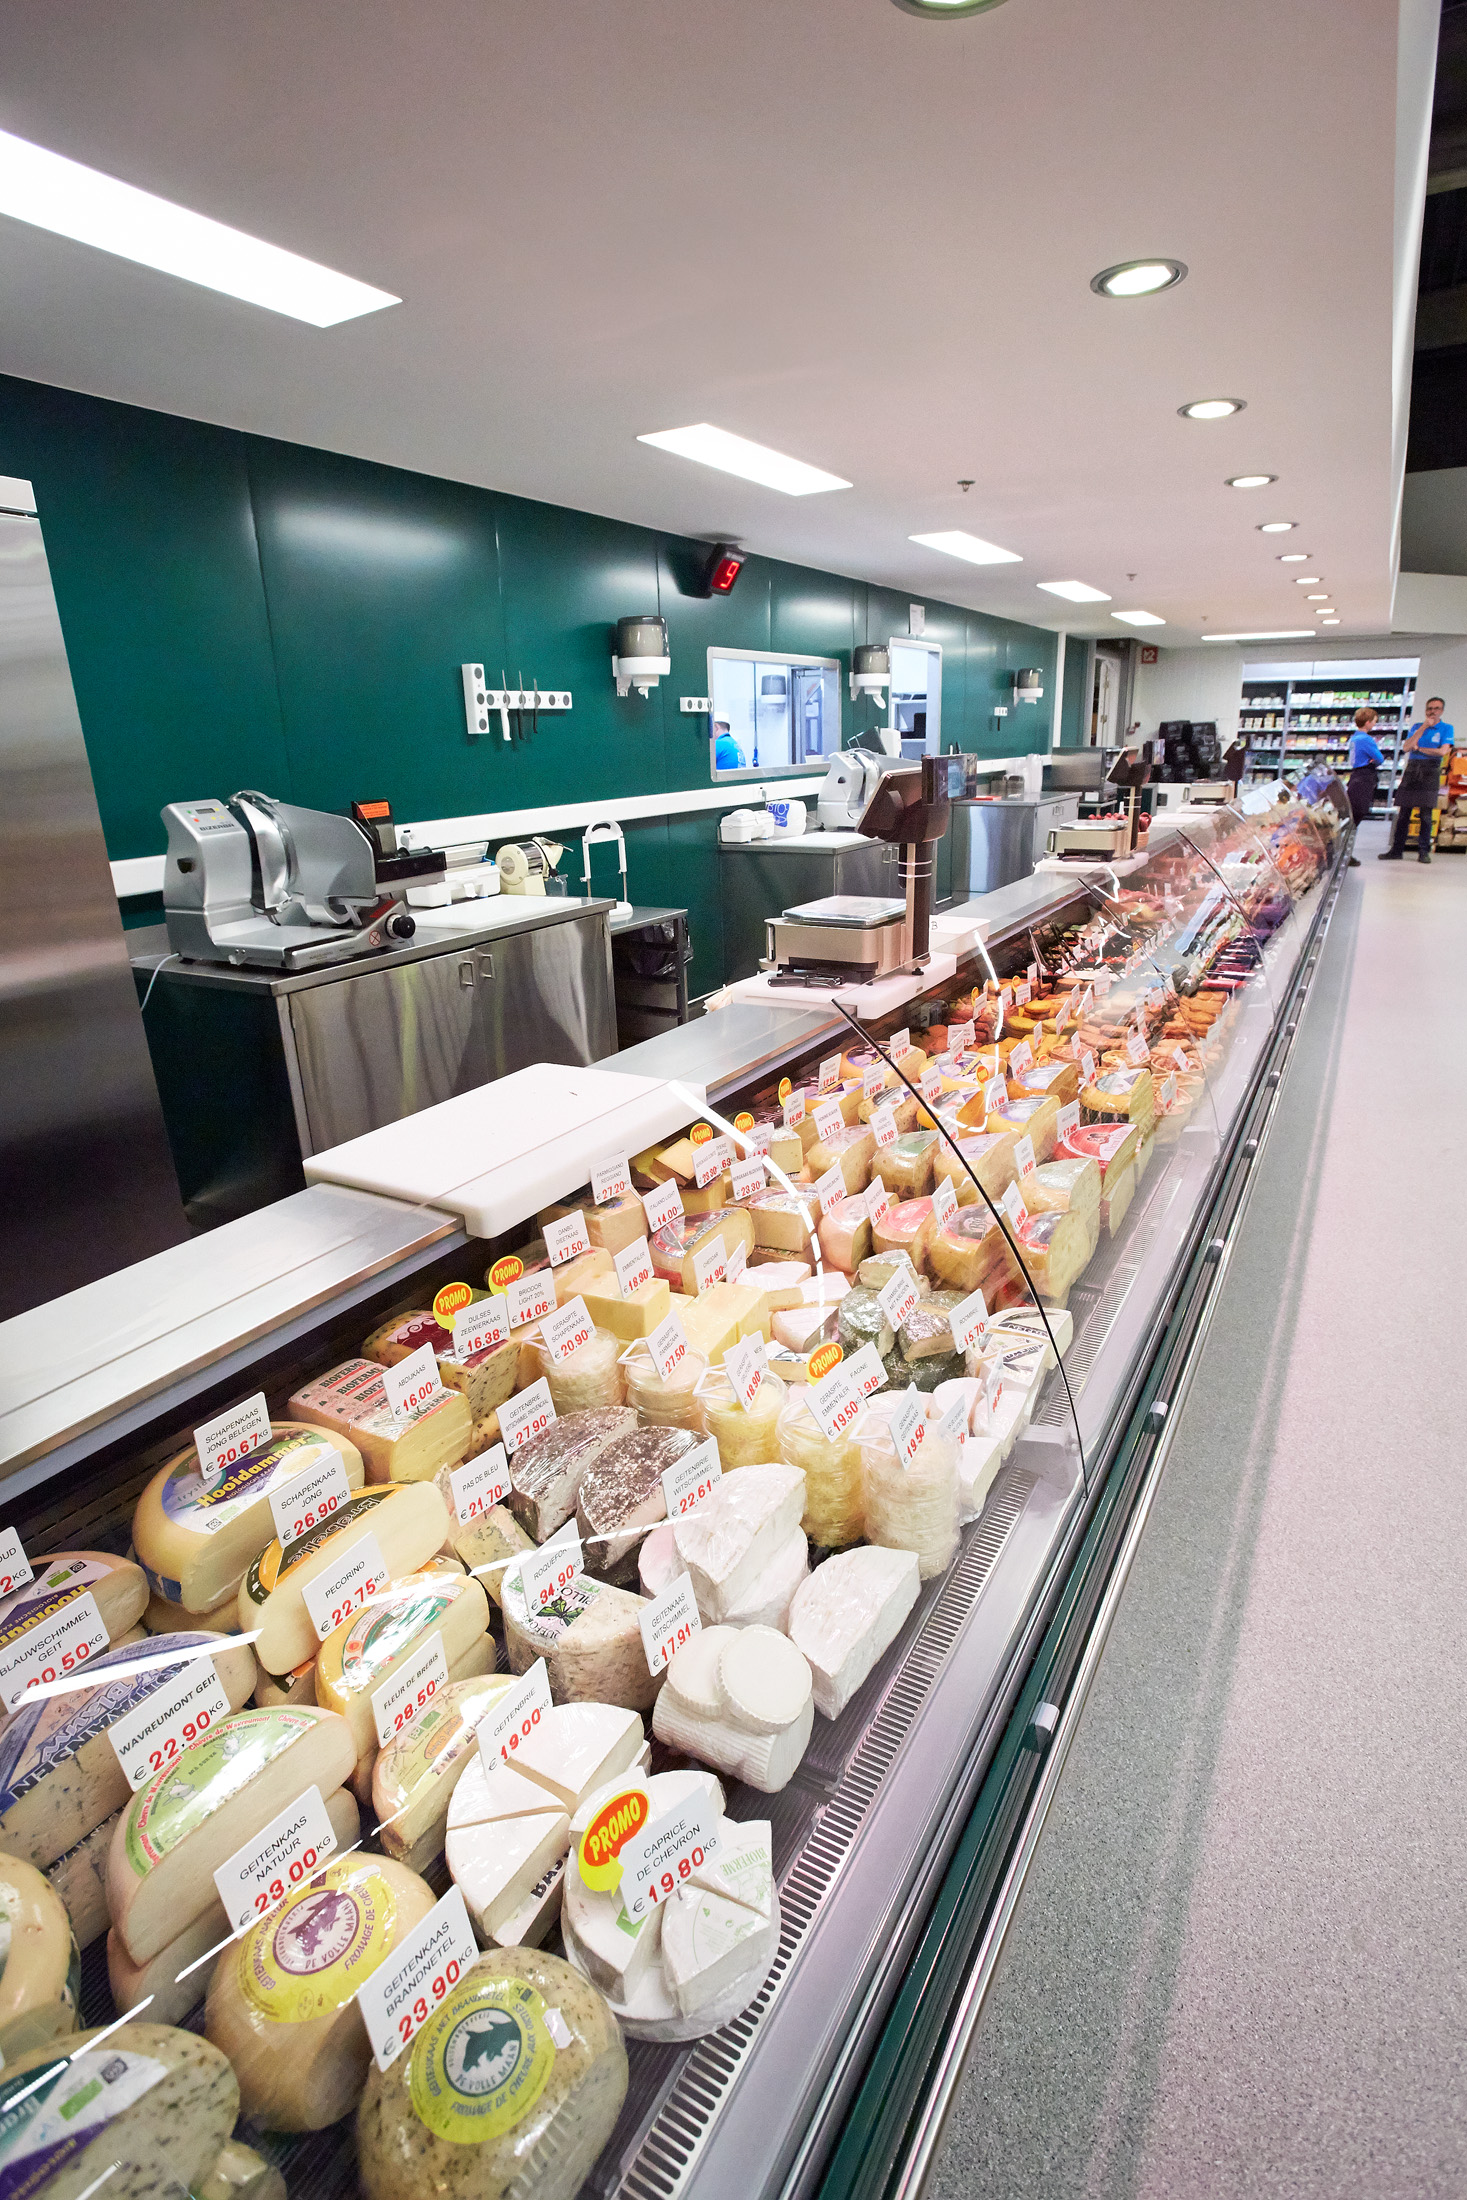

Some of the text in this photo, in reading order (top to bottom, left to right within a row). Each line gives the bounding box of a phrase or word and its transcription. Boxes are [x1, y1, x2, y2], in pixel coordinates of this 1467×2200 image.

[720, 561, 740, 589] 9
[694, 1128, 710, 1141] PROMO
[495, 1263, 519, 1282] PROMO
[439, 1288, 467, 1312] PROMO
[518, 1282, 542, 1297] BRIODOR
[518, 1291, 545, 1306] LIGHT 20%
[460, 1315, 500, 1336] ZEEWIERKAAS
[551, 1316, 585, 1342] SCHAPENKAAS
[552, 1311, 578, 1331] GERASPTE
[319, 1360, 367, 1388] BIOFERME
[398, 1365, 426, 1388] ABDIJKAAS
[811, 1347, 838, 1375] PROMO
[336, 1368, 384, 1395] BIOFERME
[819, 1380, 842, 1405] GERASPTE
[408, 1391, 455, 1421] BIOFERME
[509, 1393, 541, 1419] GEITENBRIE
[822, 1386, 850, 1416] EMMENTALER
[205, 1408, 259, 1444] SCHAPENKAAS
[206, 1416, 262, 1454] JONG BELEGEN
[196, 1436, 310, 1507] Hooidammer
[462, 1464, 498, 1492] PAS DE BLEU
[673, 1464, 713, 1496] WITSCHIMMEL
[674, 1455, 709, 1484] GEITENBRIE
[281, 1468, 336, 1510] SCHAPENKAAS
[301, 1489, 322, 1507] JONG
[325, 1561, 366, 1599] PECORINO
[533, 1548, 570, 1580] ROQUEFO
[651, 1593, 686, 1628] GEITENKAAS
[652, 1603, 690, 1641] WITSCHIMMEL
[0, 1610, 91, 1676] BLAUWSCHIMMEL
[38, 1641, 63, 1662] GEIT
[383, 1653, 439, 1710] FLEUR DE BREBIS
[118, 1691, 194, 1756] WAVREUMONT
[195, 1673, 217, 1694] GEIT
[493, 1688, 536, 1736] GEITENBRIE
[589, 1796, 641, 1861] PROMO
[643, 1819, 687, 1859] CAPRICE
[239, 1816, 308, 1880] GEITENKAAS
[256, 1838, 302, 1883] NATUUR
[636, 1824, 701, 1882] DE CHEVRON
[322, 1935, 350, 1964] VOLLE
[343, 1902, 355, 1932] MAAN
[344, 1908, 375, 1971] FROMAGE DE
[383, 1922, 450, 1999] GEITENKAAS
[386, 1936, 456, 2018] BRANDNETEL
[498, 2044, 519, 2077] MAAN
